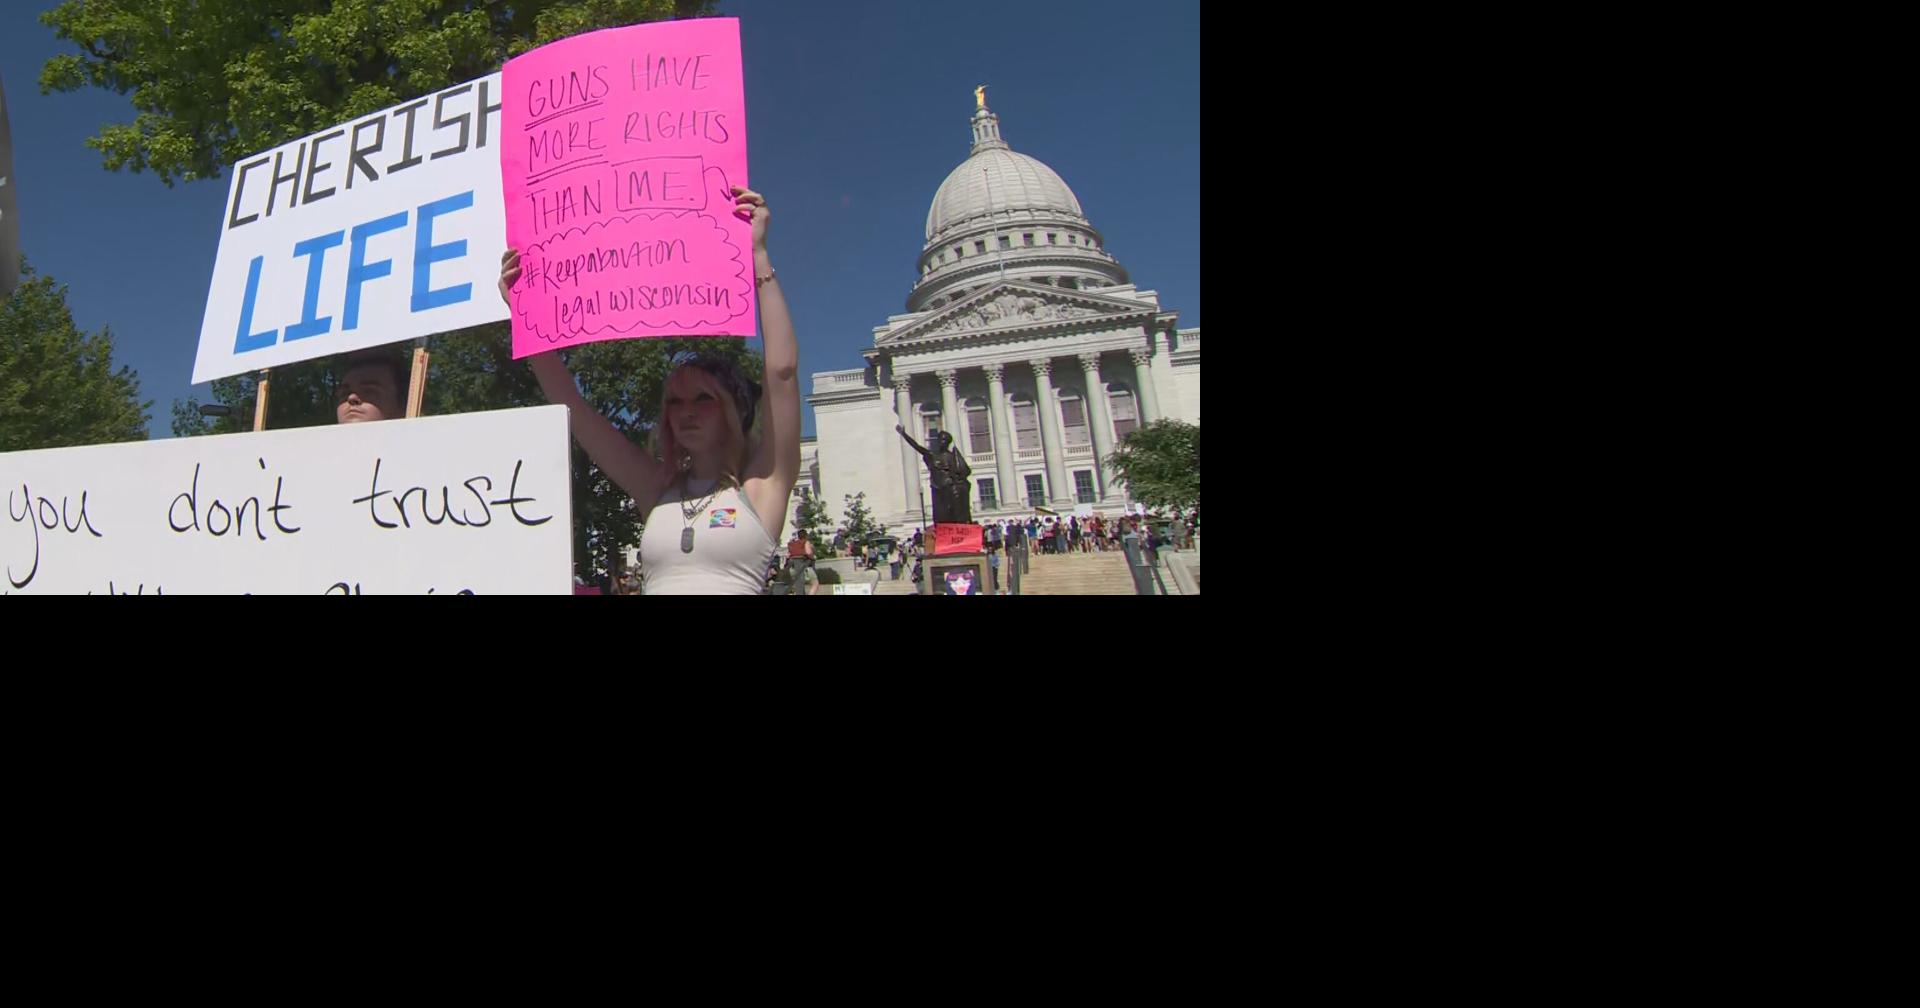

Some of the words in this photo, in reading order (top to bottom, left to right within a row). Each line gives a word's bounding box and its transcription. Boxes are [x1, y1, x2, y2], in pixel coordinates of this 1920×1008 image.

[528, 65, 609, 118] GUNS
[631, 53, 712, 92] HAVE
[228, 80, 502, 230] CHERISH
[528, 117, 607, 172] MORE
[623, 110, 729, 144] RIGHTS
[525, 180, 602, 235] THAN
[629, 170, 695, 204] ME.
[233, 190, 474, 355] LIFE
[8, 484, 102, 589] you
[169, 458, 301, 540] don't
[353, 459, 553, 529] trust
